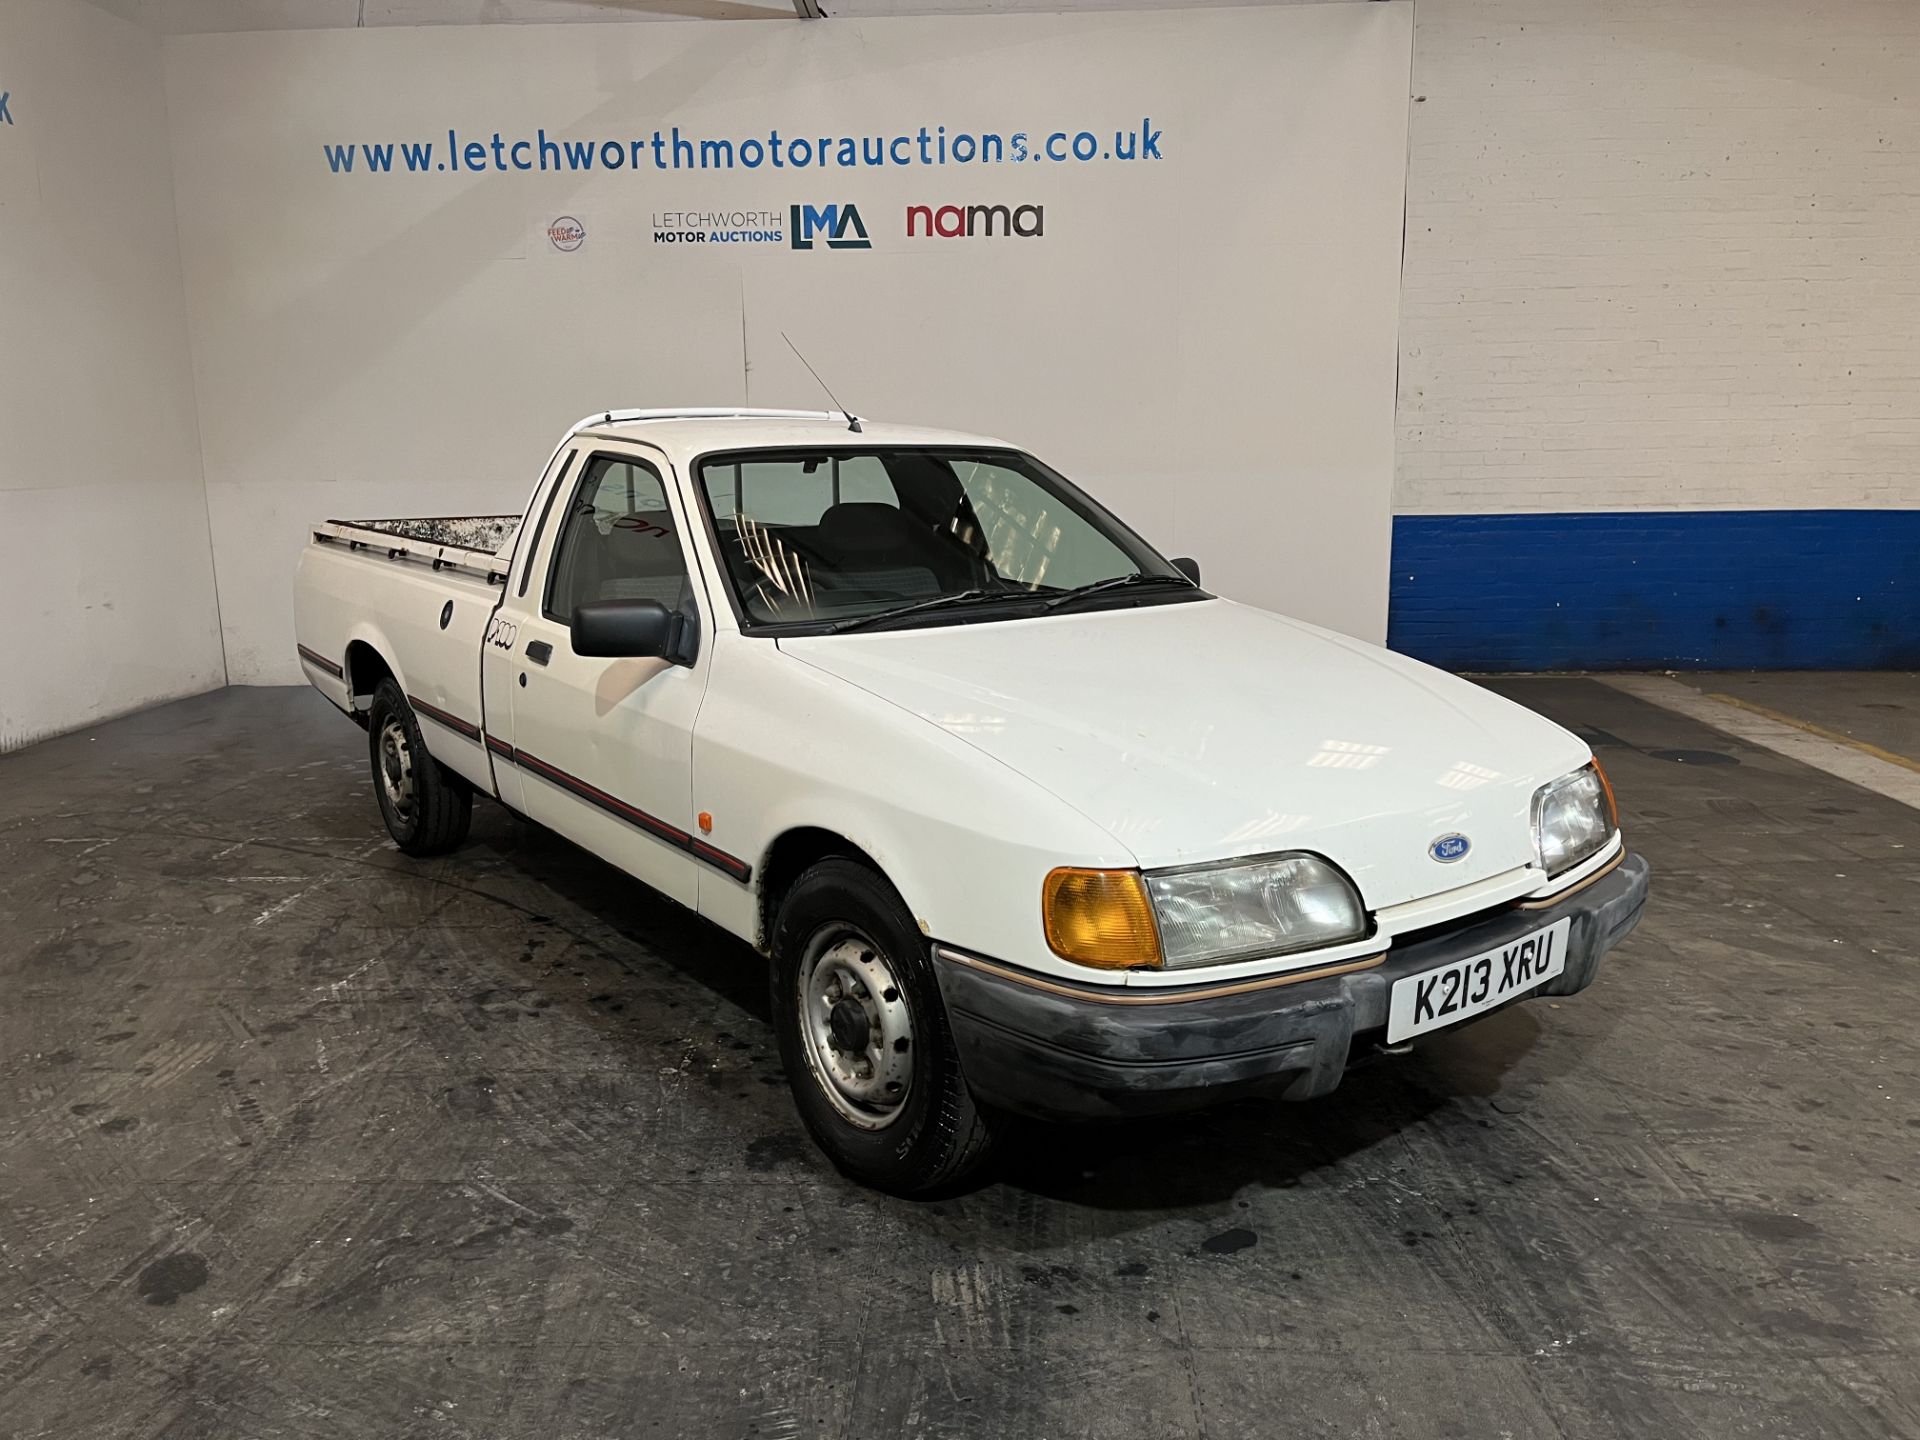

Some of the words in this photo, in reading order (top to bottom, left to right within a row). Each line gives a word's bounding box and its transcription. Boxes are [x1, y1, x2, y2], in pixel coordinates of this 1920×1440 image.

[323, 118, 1163, 173] www.letchworthmotorauctions.co.uk
[653, 212, 782, 228] LETCHWORTH
[654, 231, 706, 243] MOTOR
[709, 230, 783, 242] AUCTIONS
[790, 204, 873, 249] LMA
[907, 204, 1043, 237] nama
[1441, 839, 1464, 857] Ford
[1413, 958, 1492, 1026] K213
[1498, 930, 1554, 994] XRU
